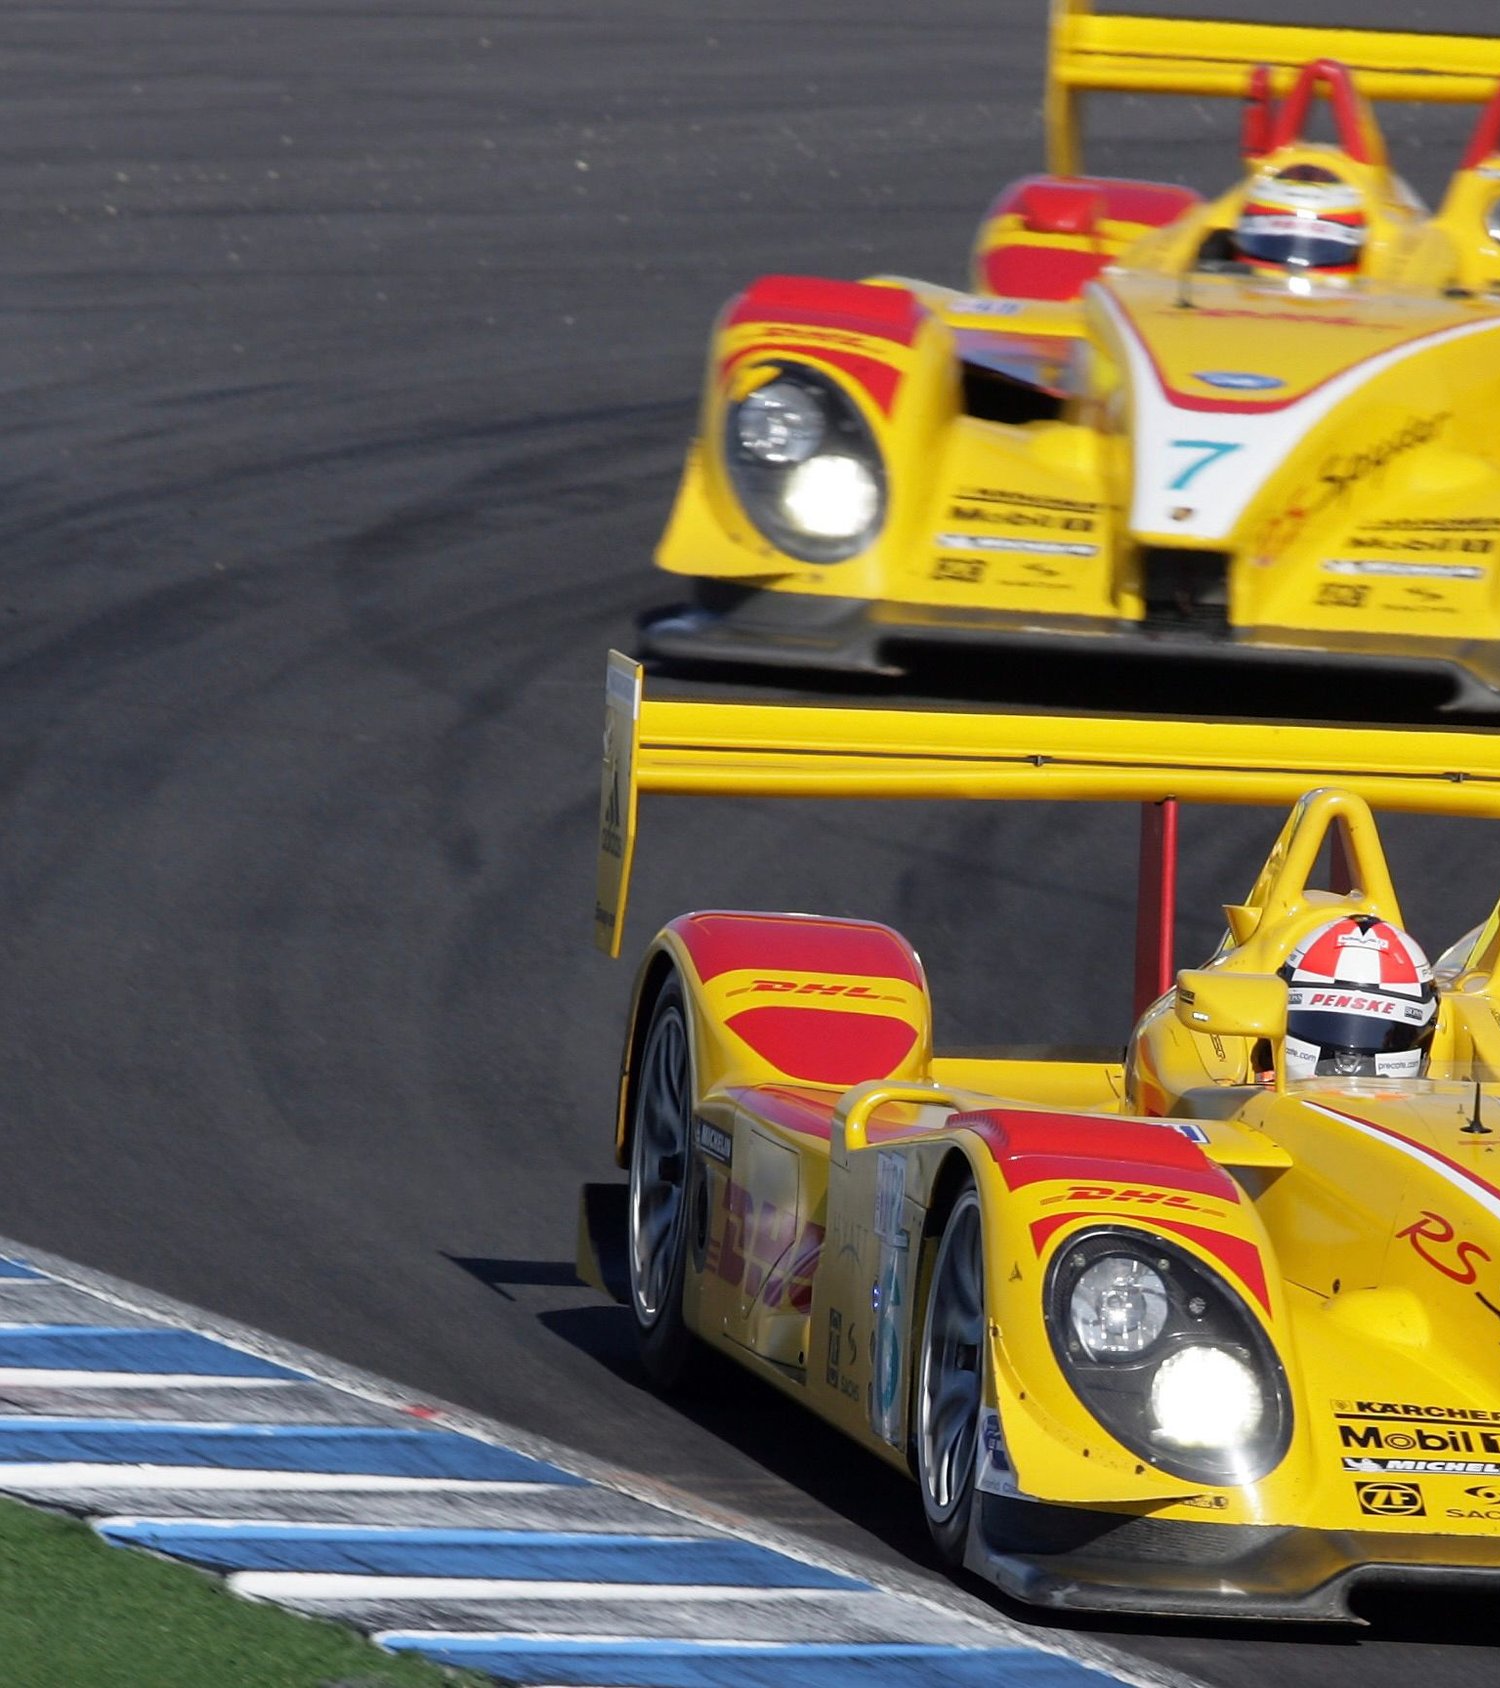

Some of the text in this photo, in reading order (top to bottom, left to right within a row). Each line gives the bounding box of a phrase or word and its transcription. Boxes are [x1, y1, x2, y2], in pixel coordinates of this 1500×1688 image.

[1167, 439, 1244, 491] 7
[751, 980, 880, 999] DHL
[1310, 994, 1396, 1014] PENSKE
[1065, 1186, 1201, 1211] DHL
[1395, 1210, 1492, 1286] RS
[1338, 1425, 1475, 1453] Mobil
[1367, 1487, 1410, 1507] ZF
